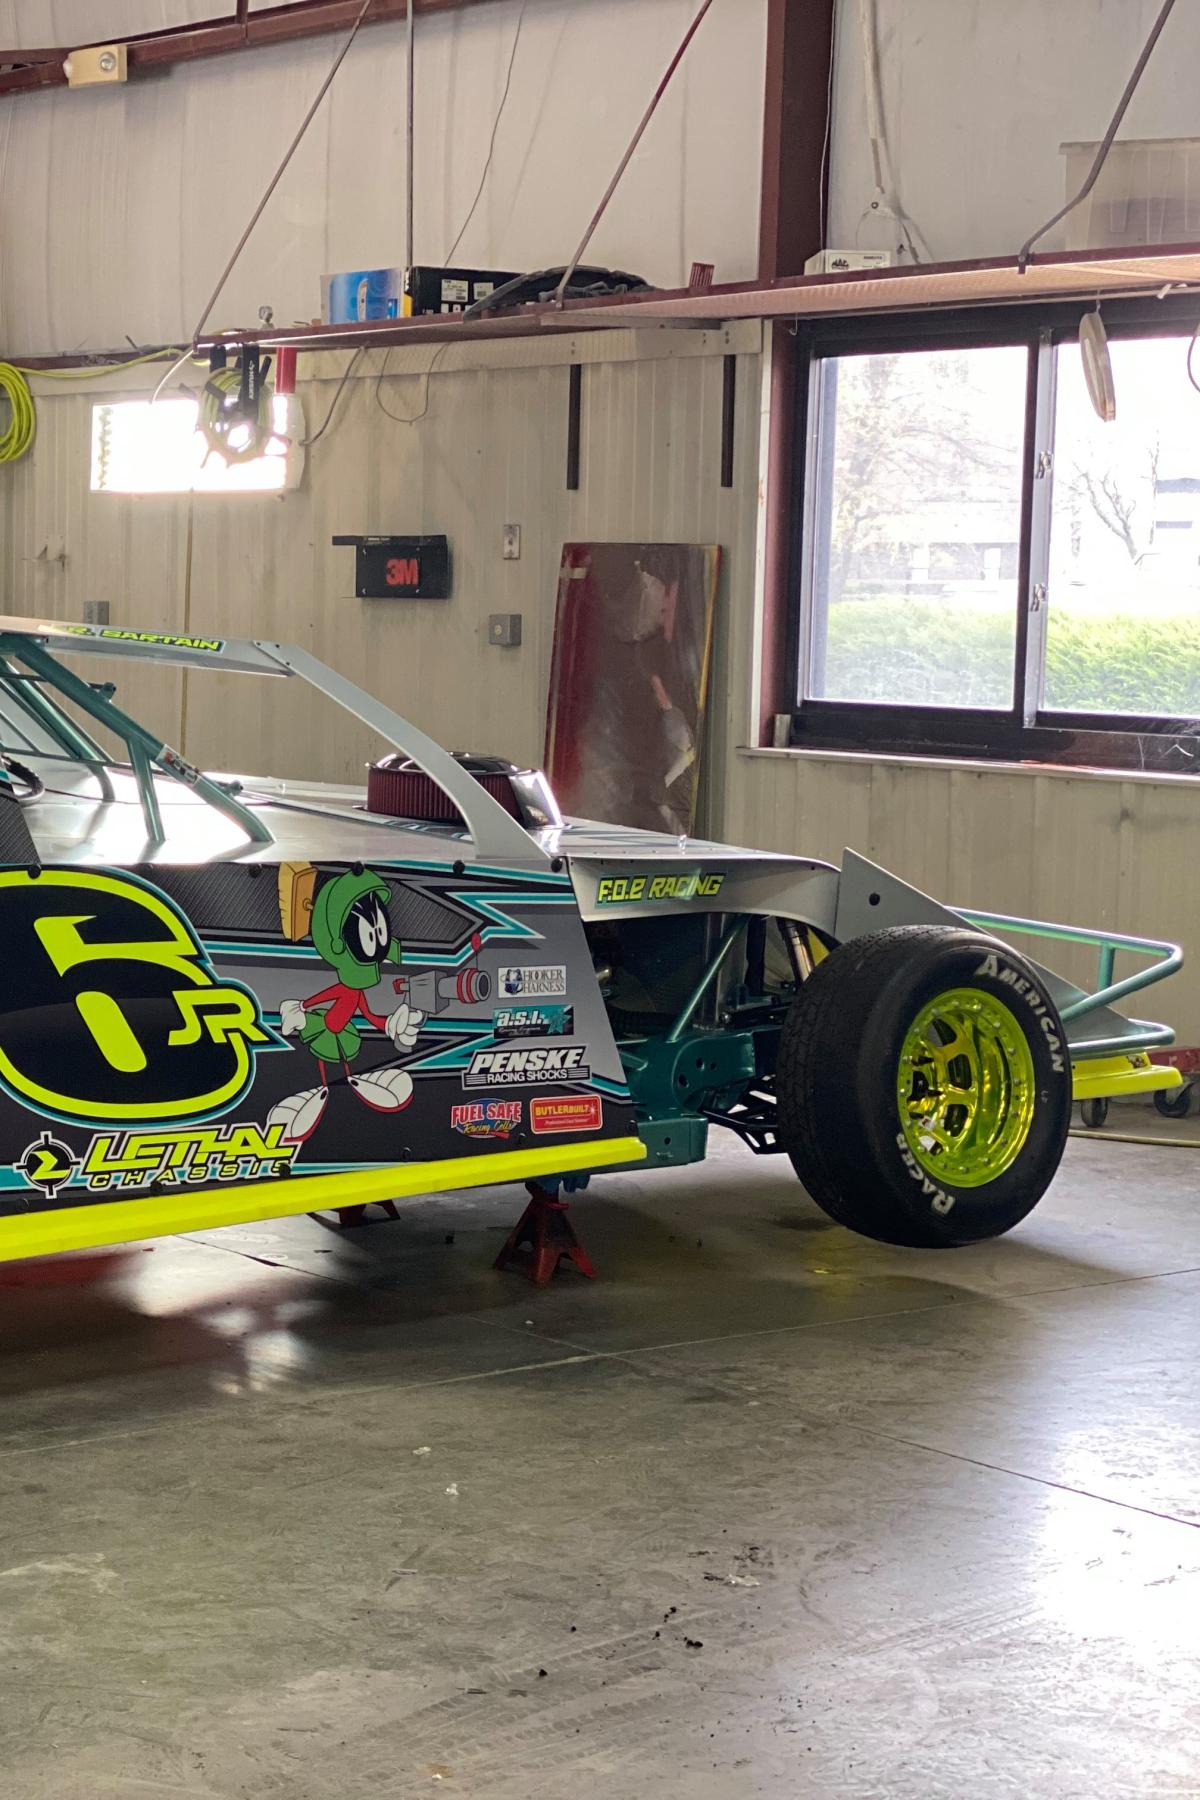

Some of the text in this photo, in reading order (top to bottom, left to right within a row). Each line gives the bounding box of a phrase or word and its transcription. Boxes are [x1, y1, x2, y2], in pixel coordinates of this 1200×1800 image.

[386, 558, 418, 586] 3M
[101, 629, 221, 651] SARTAIN
[648, 872, 726, 900] RACING
[523, 969, 564, 981] HOOKER
[523, 981, 565, 993] HARNESS
[167, 988, 269, 1047] JR
[973, 954, 1065, 1073] AMERICAN
[469, 1048, 583, 1075] PENSKE
[487, 1069, 568, 1084] RACING SHOCKS
[451, 1101, 522, 1129] FUEL SAFE
[463, 1122, 491, 1134] Racing
[84, 1125, 296, 1173] LETHAL
[91, 1159, 291, 1188] CHASSIS
[896, 1132, 957, 1216] RACER
